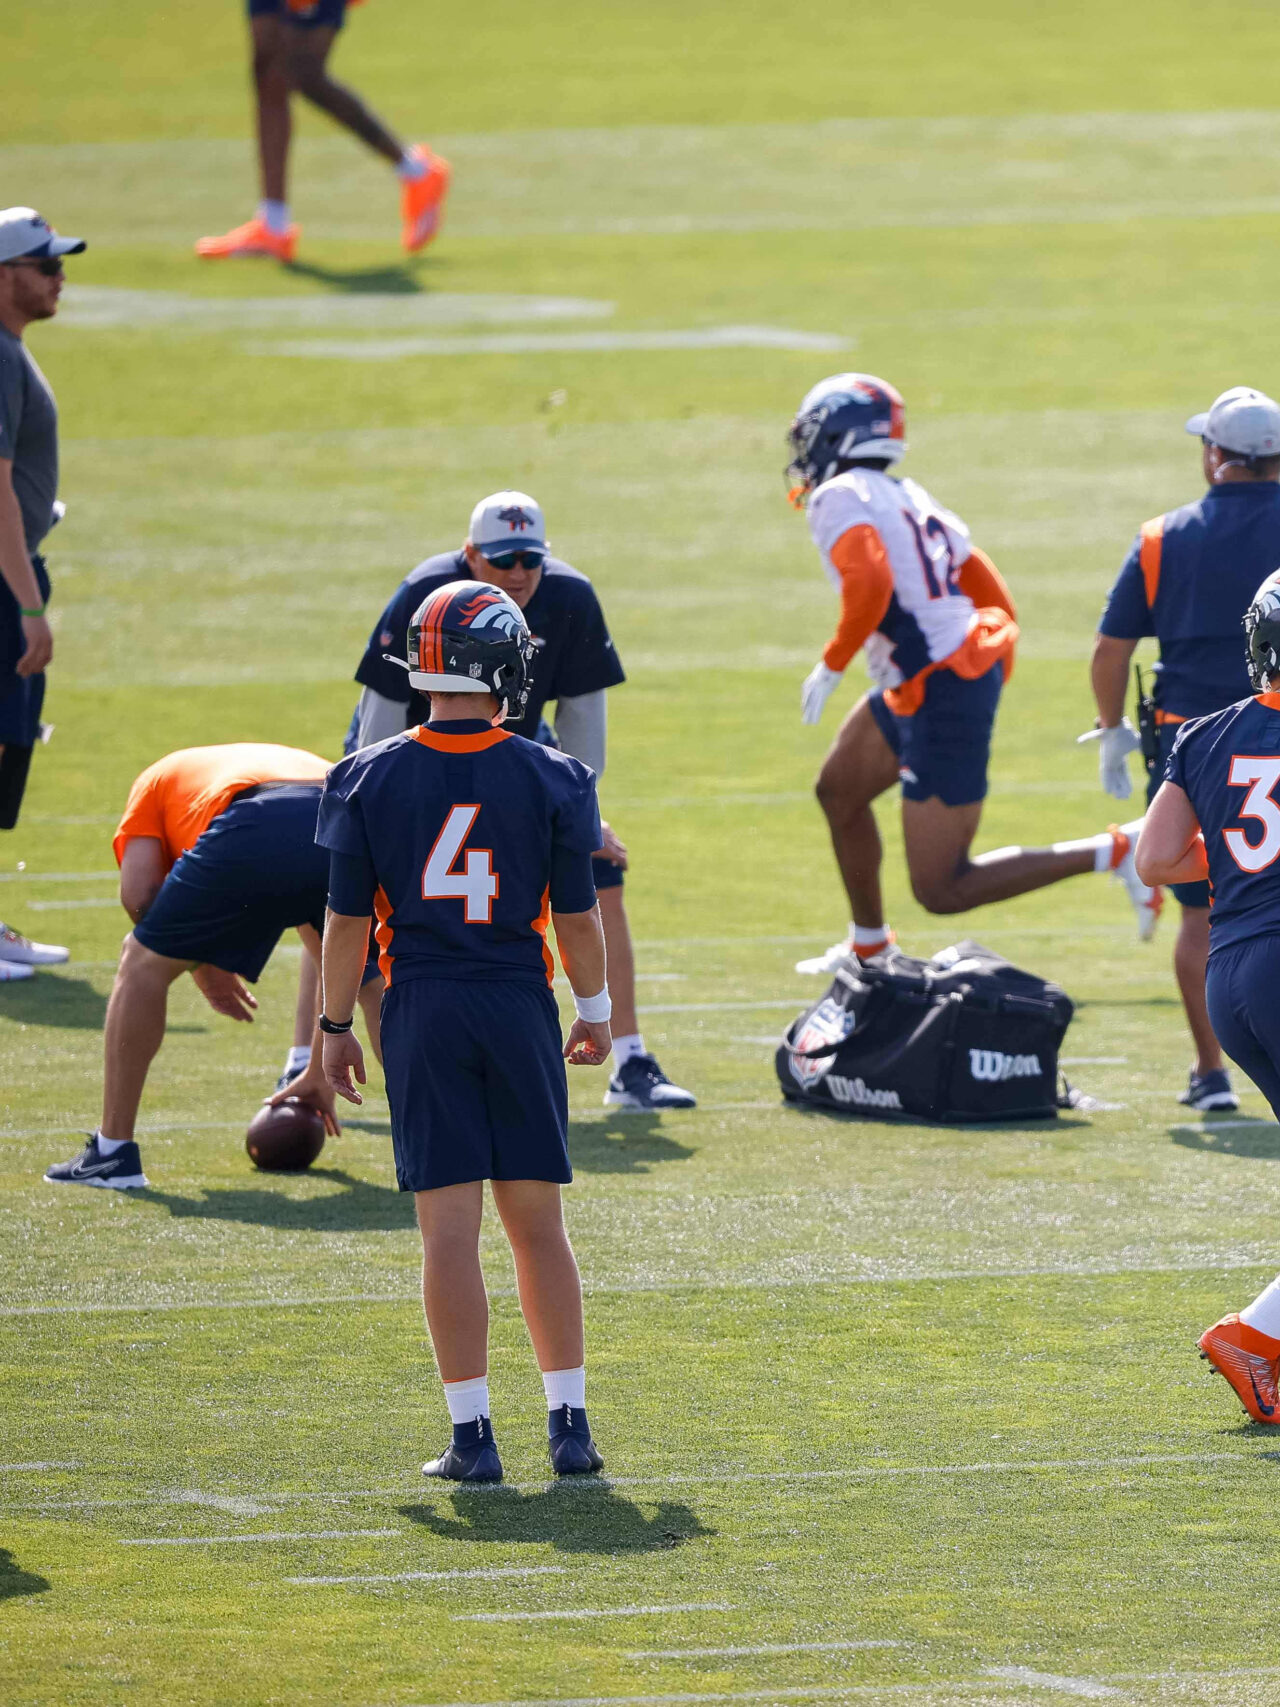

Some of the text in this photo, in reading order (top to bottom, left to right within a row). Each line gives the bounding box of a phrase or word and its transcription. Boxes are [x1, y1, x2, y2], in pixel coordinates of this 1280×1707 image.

[901, 509, 963, 600] 12
[449, 655, 457, 666] 4
[421, 803, 500, 924] 4
[968, 1048, 1043, 1081] Won
[825, 1073, 903, 1109] Wilson
